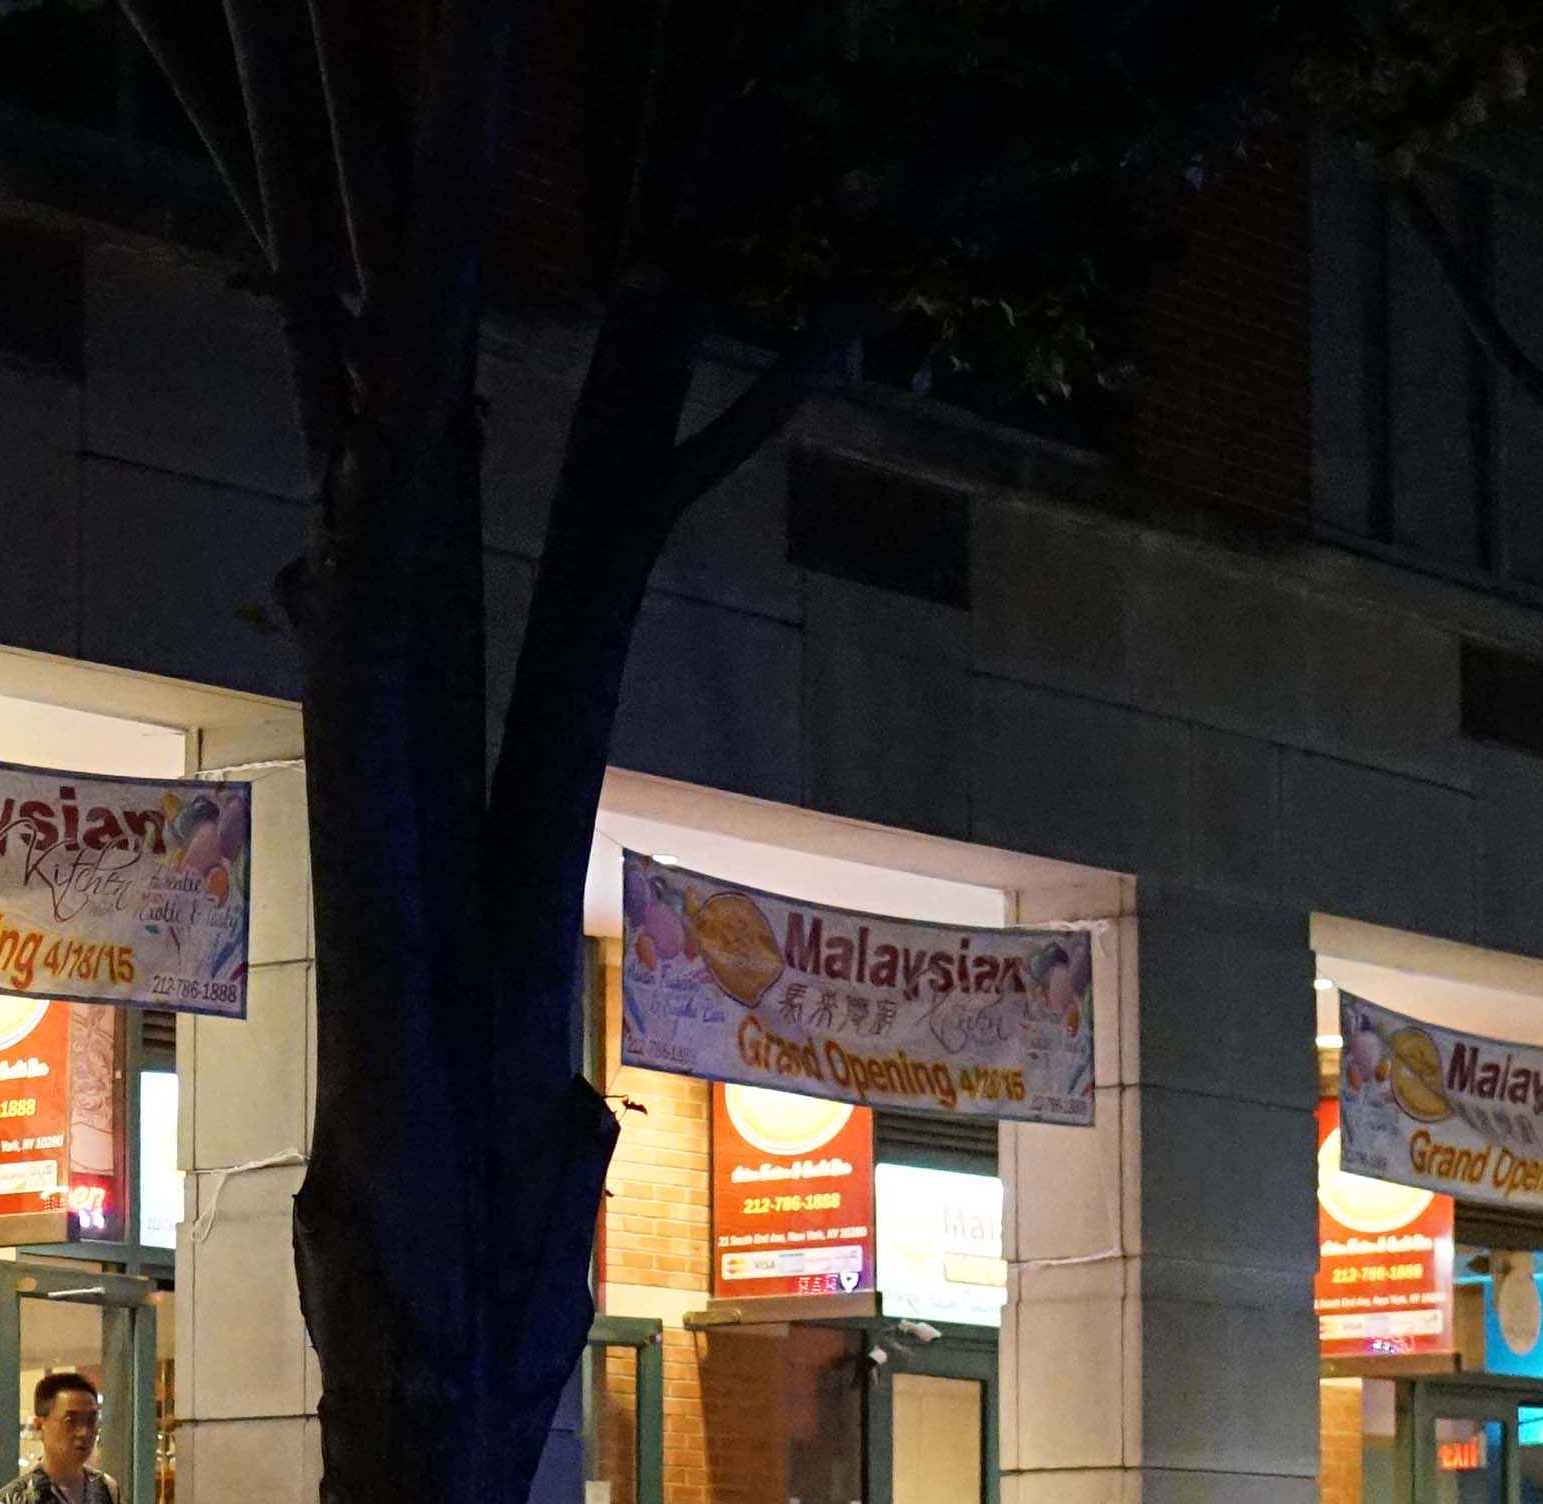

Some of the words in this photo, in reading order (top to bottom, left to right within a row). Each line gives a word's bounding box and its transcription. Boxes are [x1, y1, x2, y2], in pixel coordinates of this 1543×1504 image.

[43, 940, 135, 984] 4/18/15
[783, 912, 1027, 1000] Malaysian
[152, 975, 238, 1003] 212-786-1888
[738, 1014, 823, 1082] Grand
[825, 1038, 957, 1109] Opening
[1409, 1129, 1491, 1185] Grand
[743, 1192, 841, 1214] 212-786-1888
